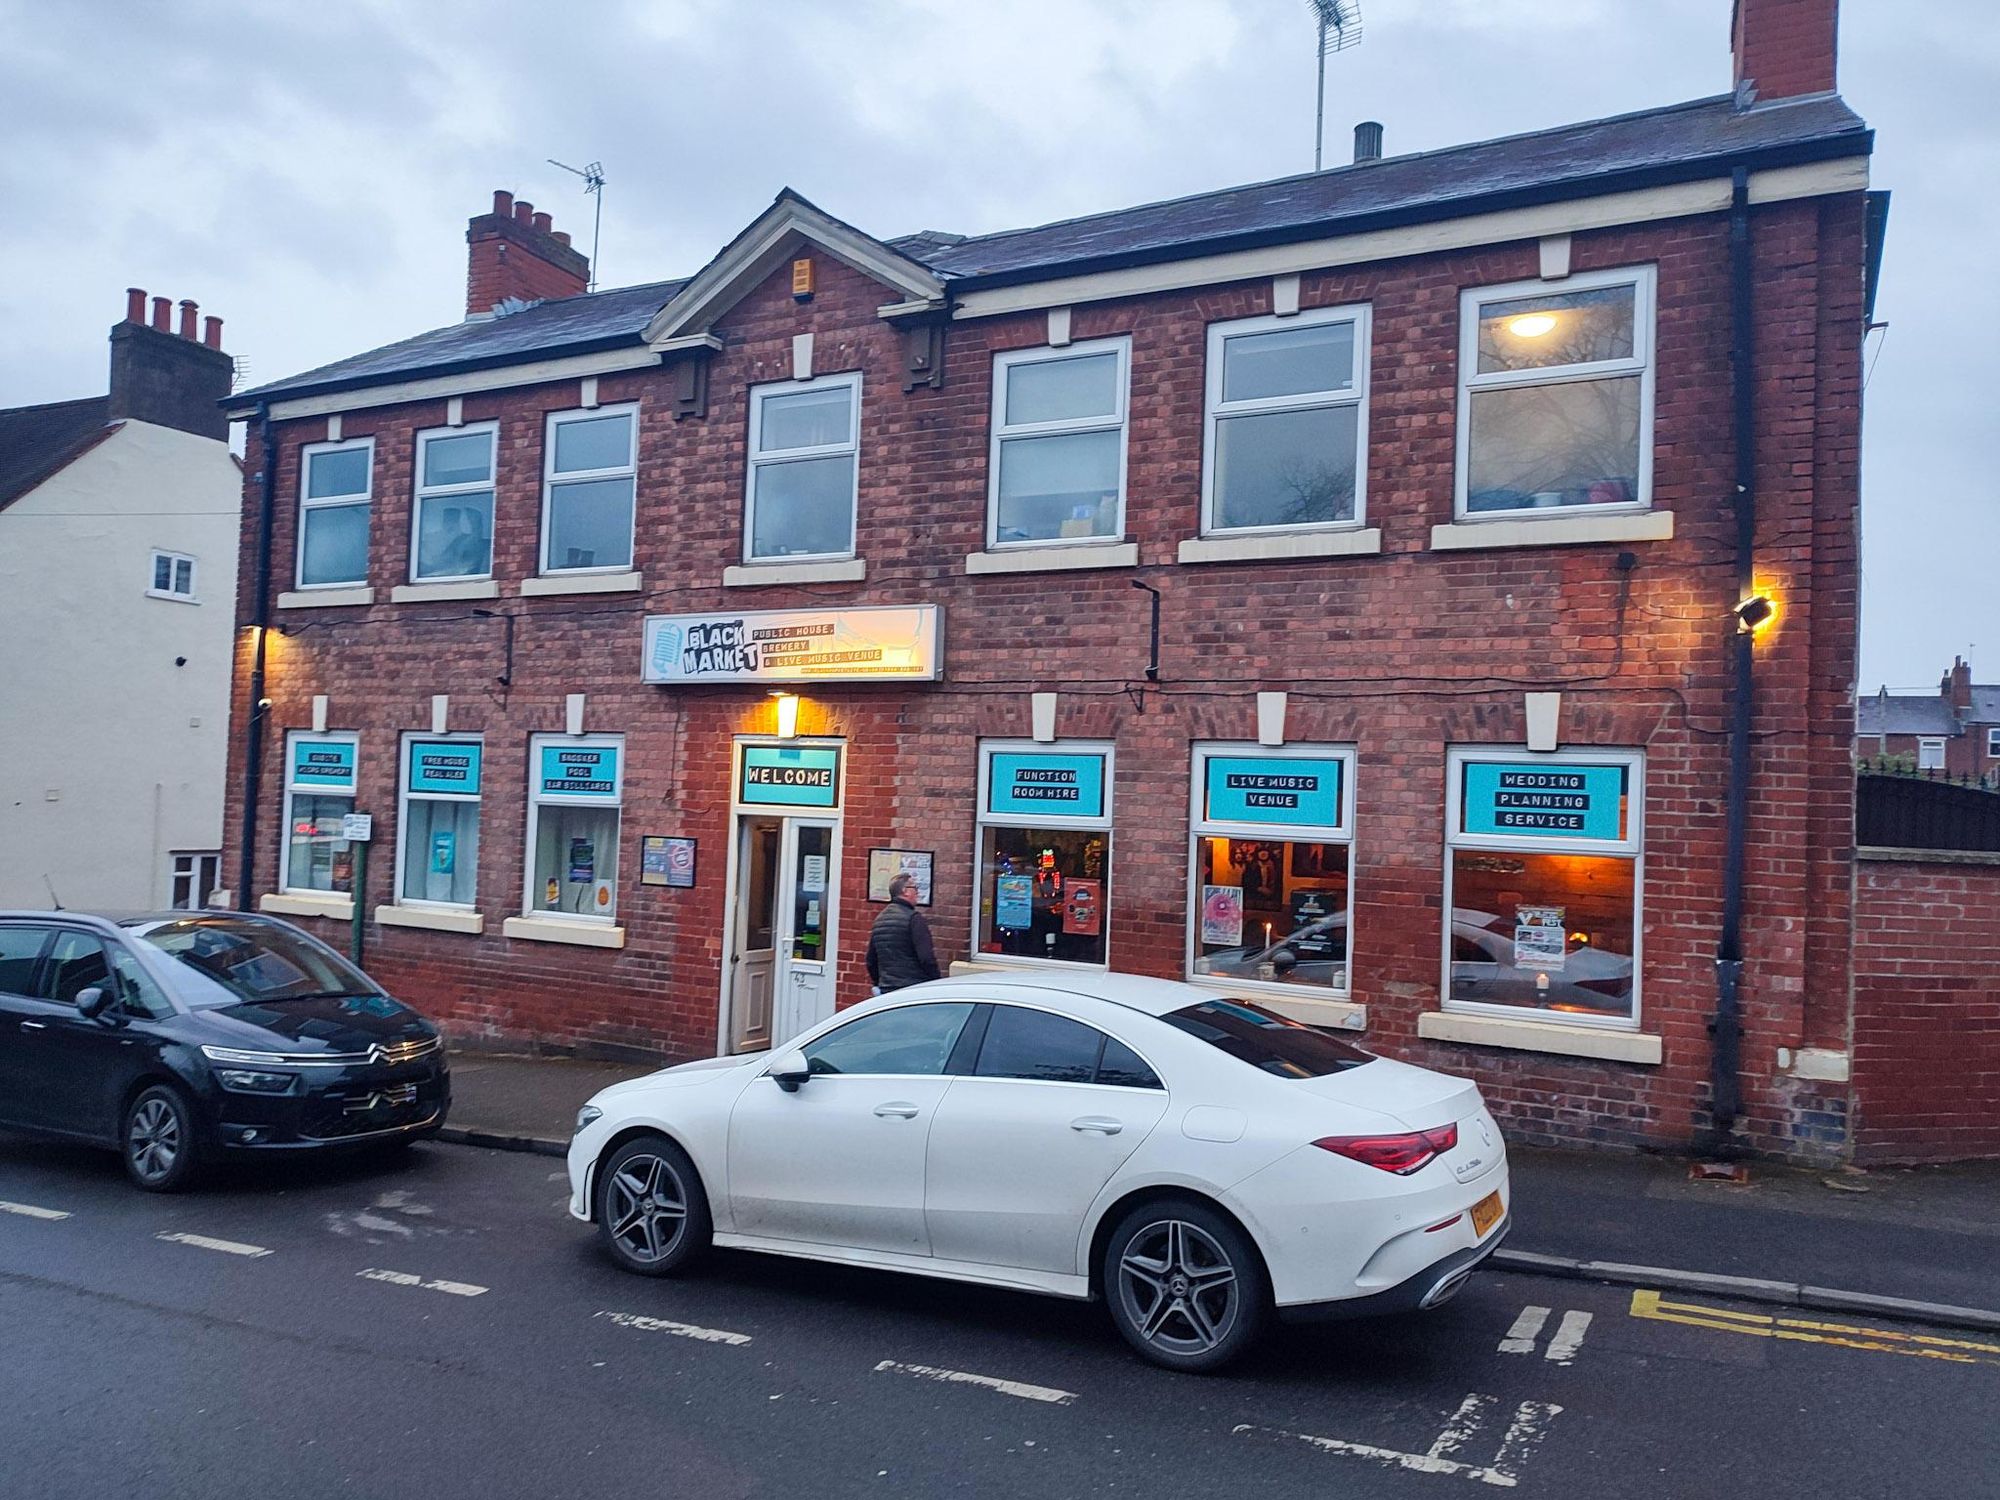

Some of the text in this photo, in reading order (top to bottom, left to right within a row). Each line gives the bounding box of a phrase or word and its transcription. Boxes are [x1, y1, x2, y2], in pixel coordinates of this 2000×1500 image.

[688, 624, 744, 649] BLACK
[753, 627, 790, 639] PUBLIC
[683, 645, 757, 672] MARKET
[776, 655, 802, 666] LIVE
[808, 652, 841, 664] MUSIC
[848, 649, 880, 661] VENUE
[423, 757, 468, 767] FREE HOUSE
[445, 771, 465, 779] ALES
[568, 767, 590, 776] POOL
[748, 767, 831, 786] WELCOME
[1017, 771, 1075, 781] FUNCTION
[546, 780, 611, 791] BAR BILLIARDS
[1230, 776, 1314, 788] LIVE MUSIC
[1505, 775, 1579, 787] WEDDING
[1013, 787, 1077, 799] ROOM HIRE
[1249, 794, 1293, 806] VENUE
[1501, 794, 1583, 808] PLANNING
[1504, 814, 1578, 827] SERVICE
